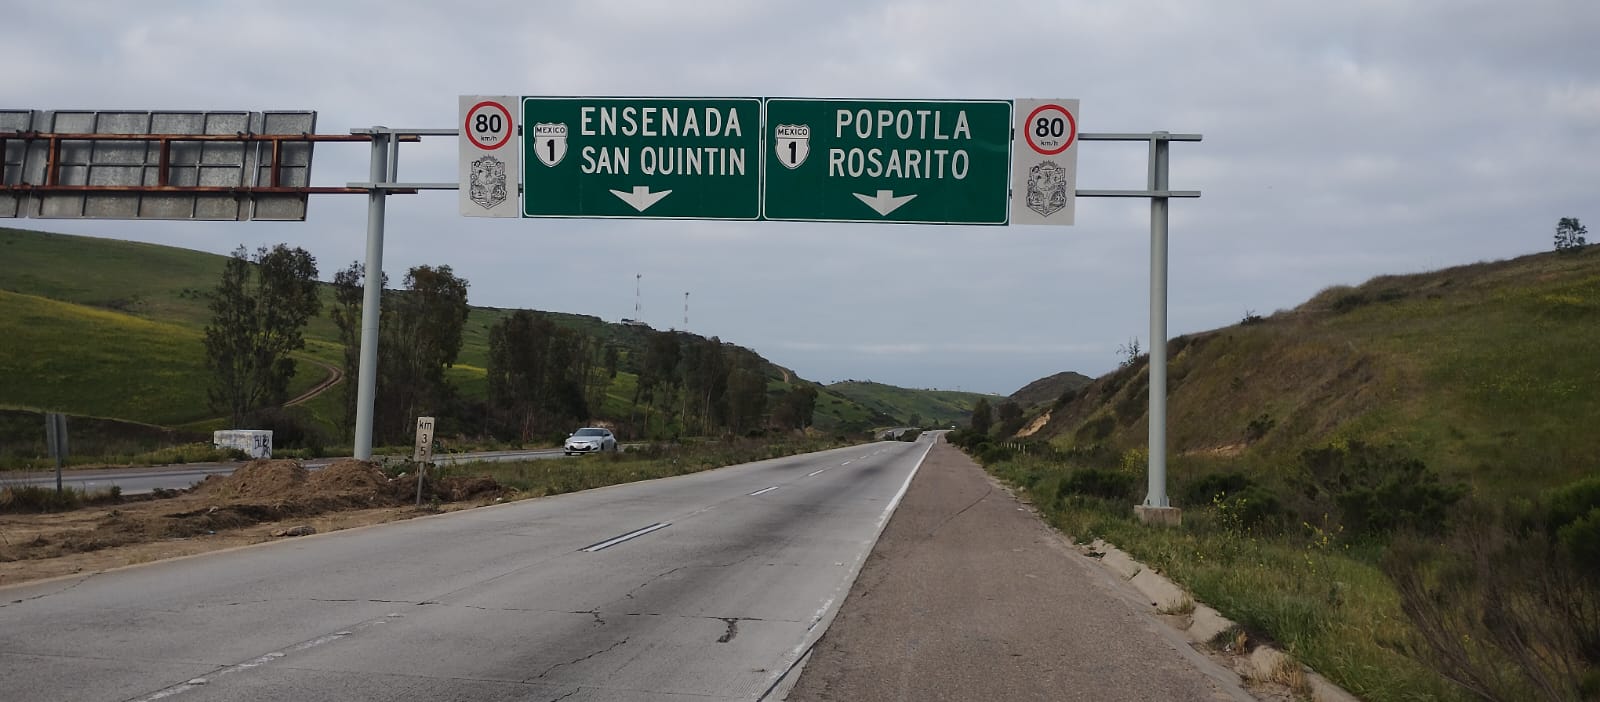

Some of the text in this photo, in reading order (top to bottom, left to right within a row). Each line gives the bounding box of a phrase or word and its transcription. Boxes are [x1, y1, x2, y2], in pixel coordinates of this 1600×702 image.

[475, 114, 502, 133] 80
[536, 126, 566, 134] MEXICO
[581, 106, 742, 136] ENSENADA
[777, 128, 808, 136] MEXICO
[836, 109, 971, 139] POPOTLA
[1035, 117, 1064, 137] 80
[547, 139, 555, 161] 1
[581, 146, 745, 176] SAN QUINTIN
[788, 141, 796, 163] 1
[829, 148, 969, 179] ROSARITO
[419, 421, 432, 430] km
